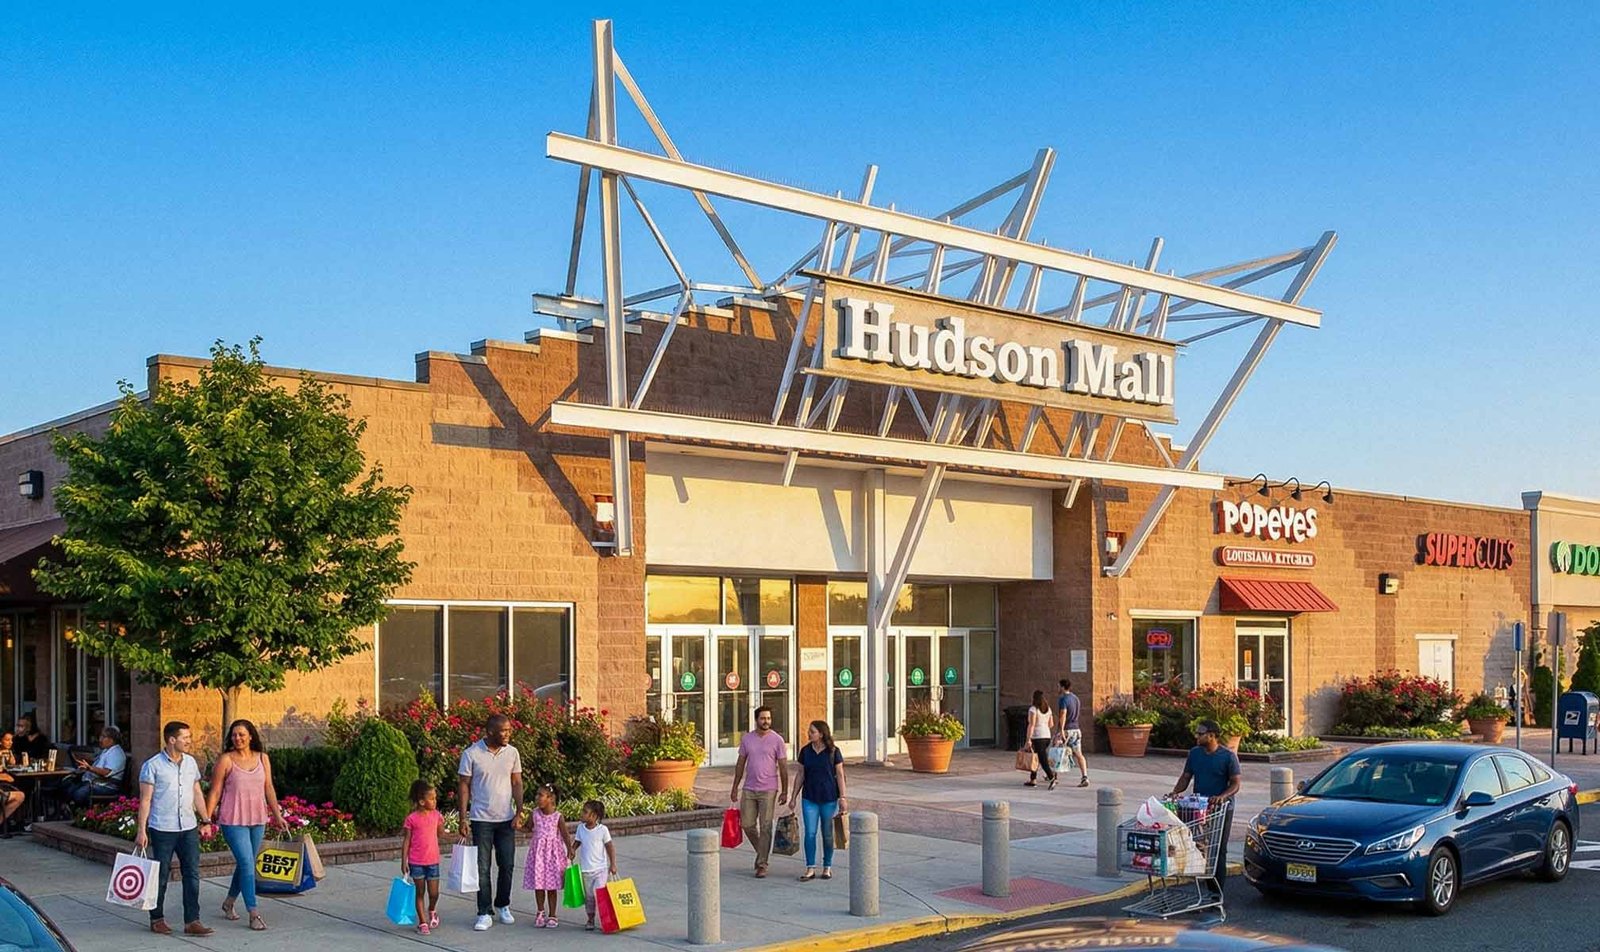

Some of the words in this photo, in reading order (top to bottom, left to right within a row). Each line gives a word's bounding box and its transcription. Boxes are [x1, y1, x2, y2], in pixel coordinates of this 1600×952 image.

[842, 298, 1060, 388] Hudson
[1070, 338, 1174, 406] Mall
[1226, 549, 1273, 564] LOUISIANA
[1275, 552, 1314, 566] KITCHEN
[1424, 532, 1516, 570] SUPERCUTS
[1573, 544, 1600, 576] DO
[261, 863, 293, 876] BUY
[262, 853, 298, 867] BEST
